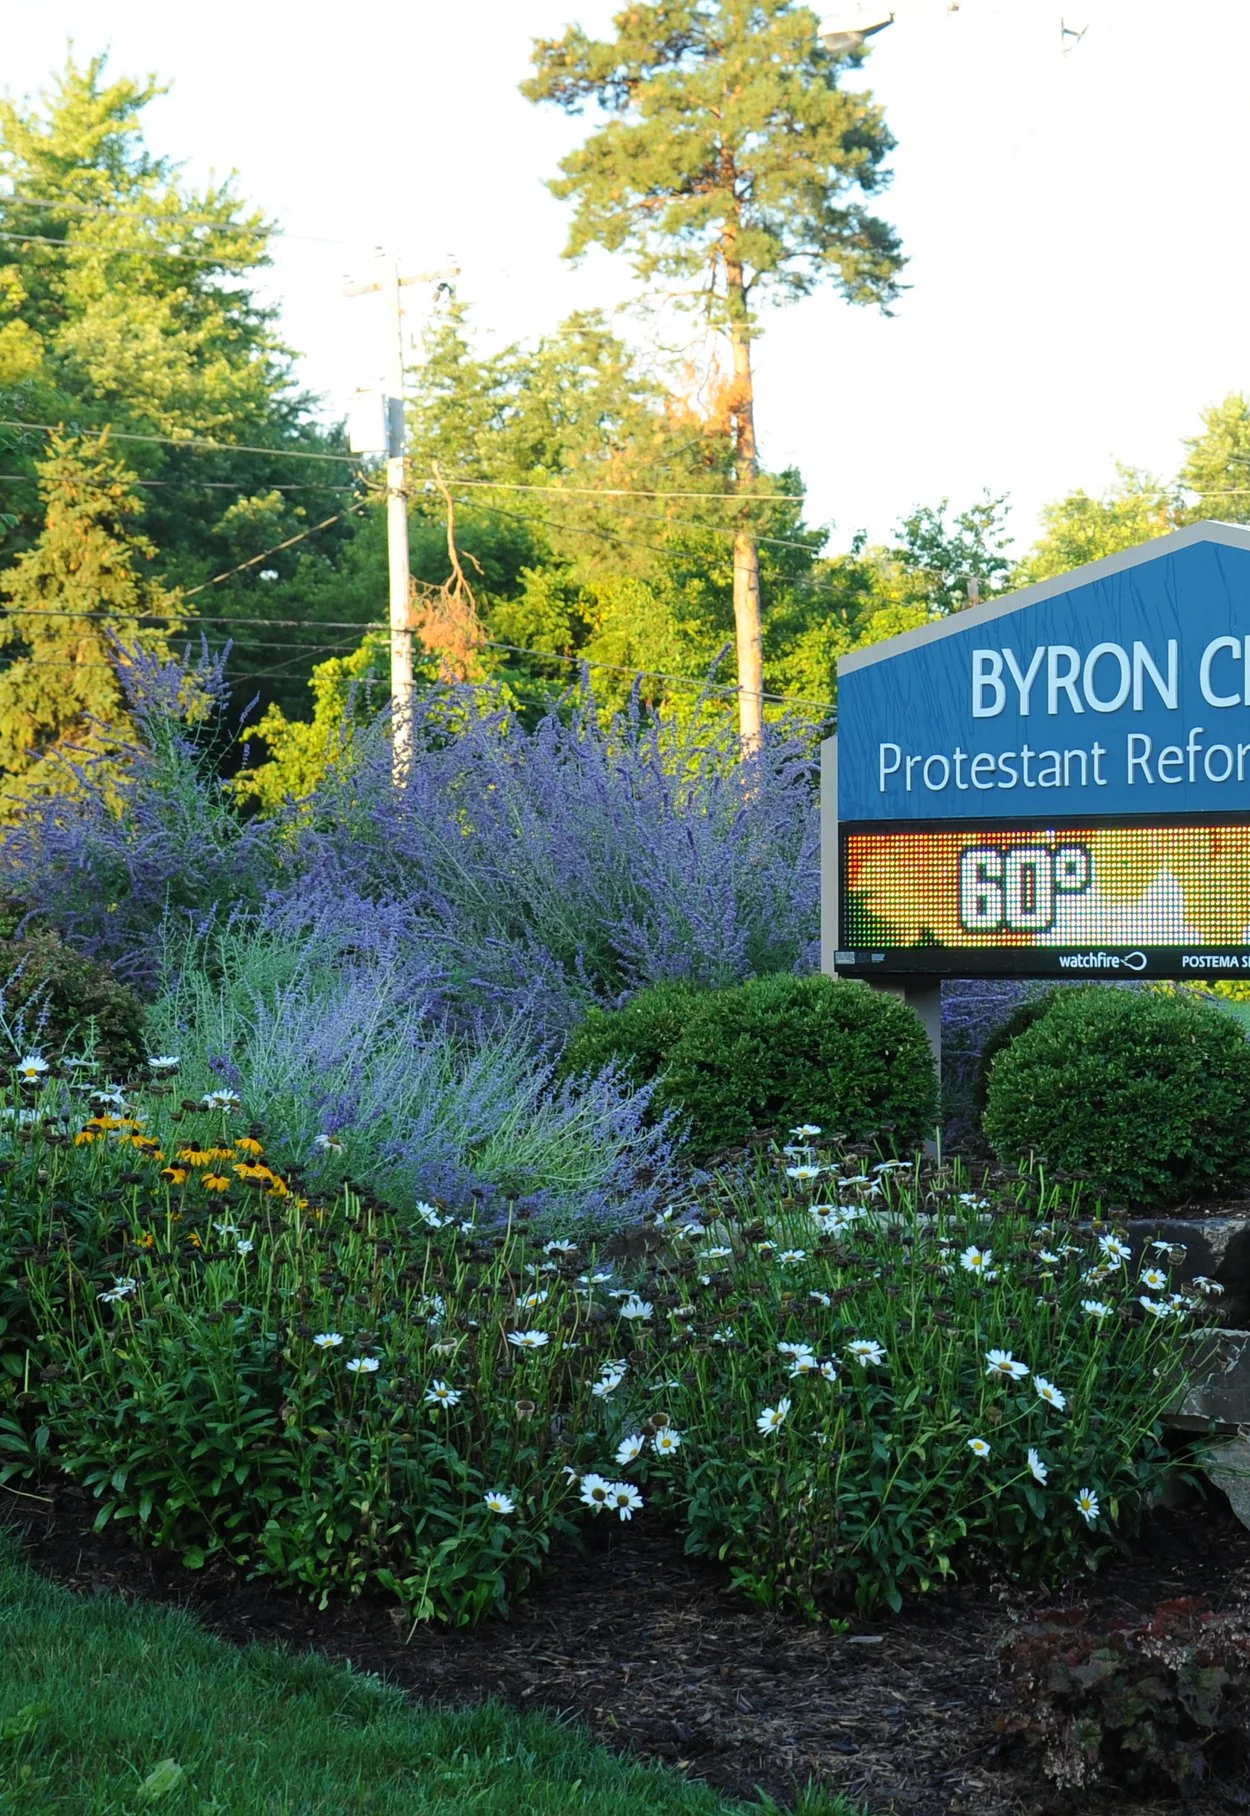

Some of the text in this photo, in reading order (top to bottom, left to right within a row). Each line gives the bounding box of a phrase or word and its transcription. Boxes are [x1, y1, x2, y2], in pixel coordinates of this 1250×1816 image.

[972, 639, 1179, 718] BYRON
[879, 741, 1107, 793] Protestant
[1059, 951, 1120, 969] watchfire
[1182, 955, 1239, 968] POSTEMA
